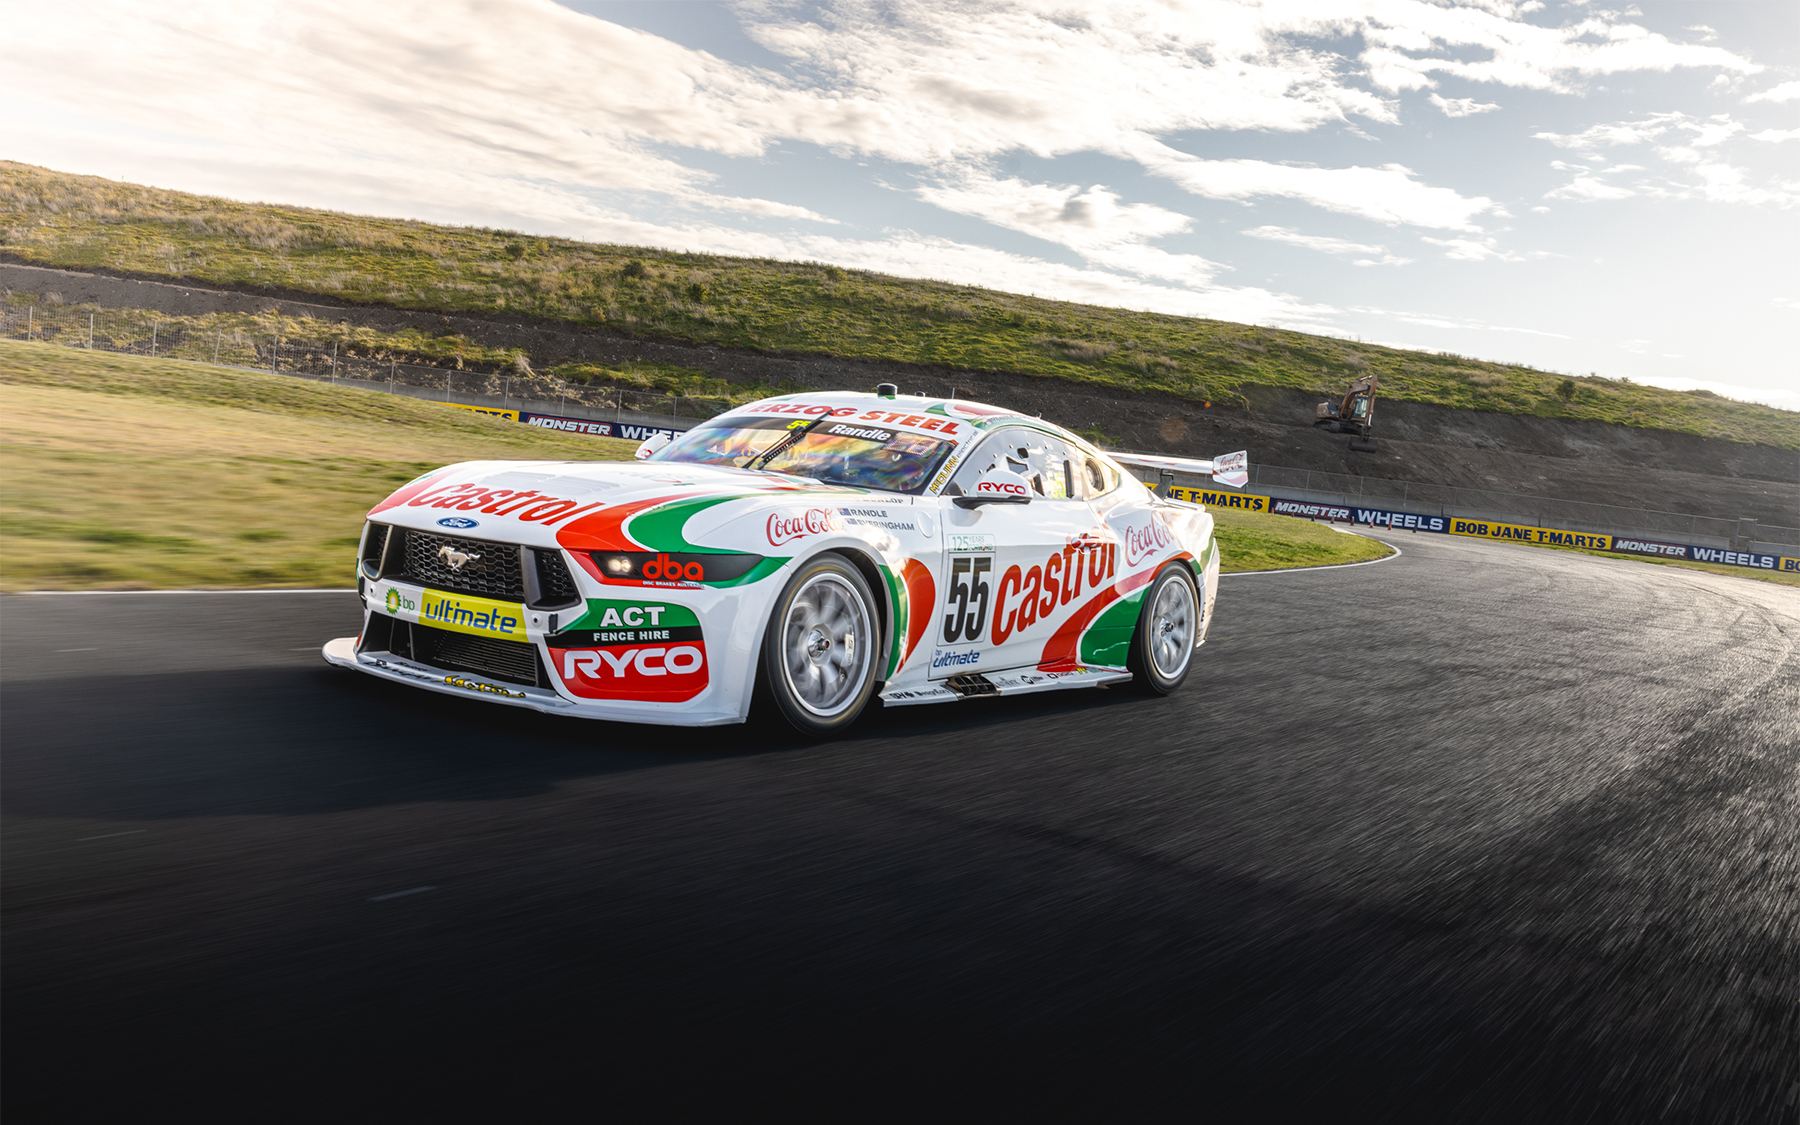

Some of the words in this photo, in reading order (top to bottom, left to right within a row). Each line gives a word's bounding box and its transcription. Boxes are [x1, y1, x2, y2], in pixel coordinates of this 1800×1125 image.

[528, 416, 611, 436] MONSTER
[621, 425, 686, 443] WHE
[828, 424, 892, 441] Randle
[859, 410, 959, 435] STEEL
[978, 482, 1026, 495] RYCO
[1046, 472, 1065, 499] 55
[408, 483, 606, 525] Castrol
[850, 509, 888, 518] RANDLE
[1189, 490, 1263, 511] T-MARTS
[857, 519, 915, 531] EVERINGHAM
[1275, 501, 1350, 519] MONSTER
[1357, 509, 1443, 531] WHEELS
[952, 536, 968, 551] 125
[1455, 521, 1488, 535] BOB
[1491, 526, 1532, 540] JANE
[1537, 530, 1606, 548] T-MARTS
[642, 553, 704, 581] dba
[1615, 539, 1686, 556] MONSTER
[1693, 547, 1774, 569] WHEELS
[1784, 559, 1800, 572] BO
[991, 511, 1116, 646] Castrol
[943, 557, 992, 643] 55
[402, 595, 415, 613] bp
[425, 599, 517, 634] ultimate
[599, 605, 666, 628] ACT
[593, 631, 635, 642] FENCE
[639, 630, 670, 640] HIRE
[564, 645, 703, 680] RYCO
[933, 649, 981, 668] ultimate
